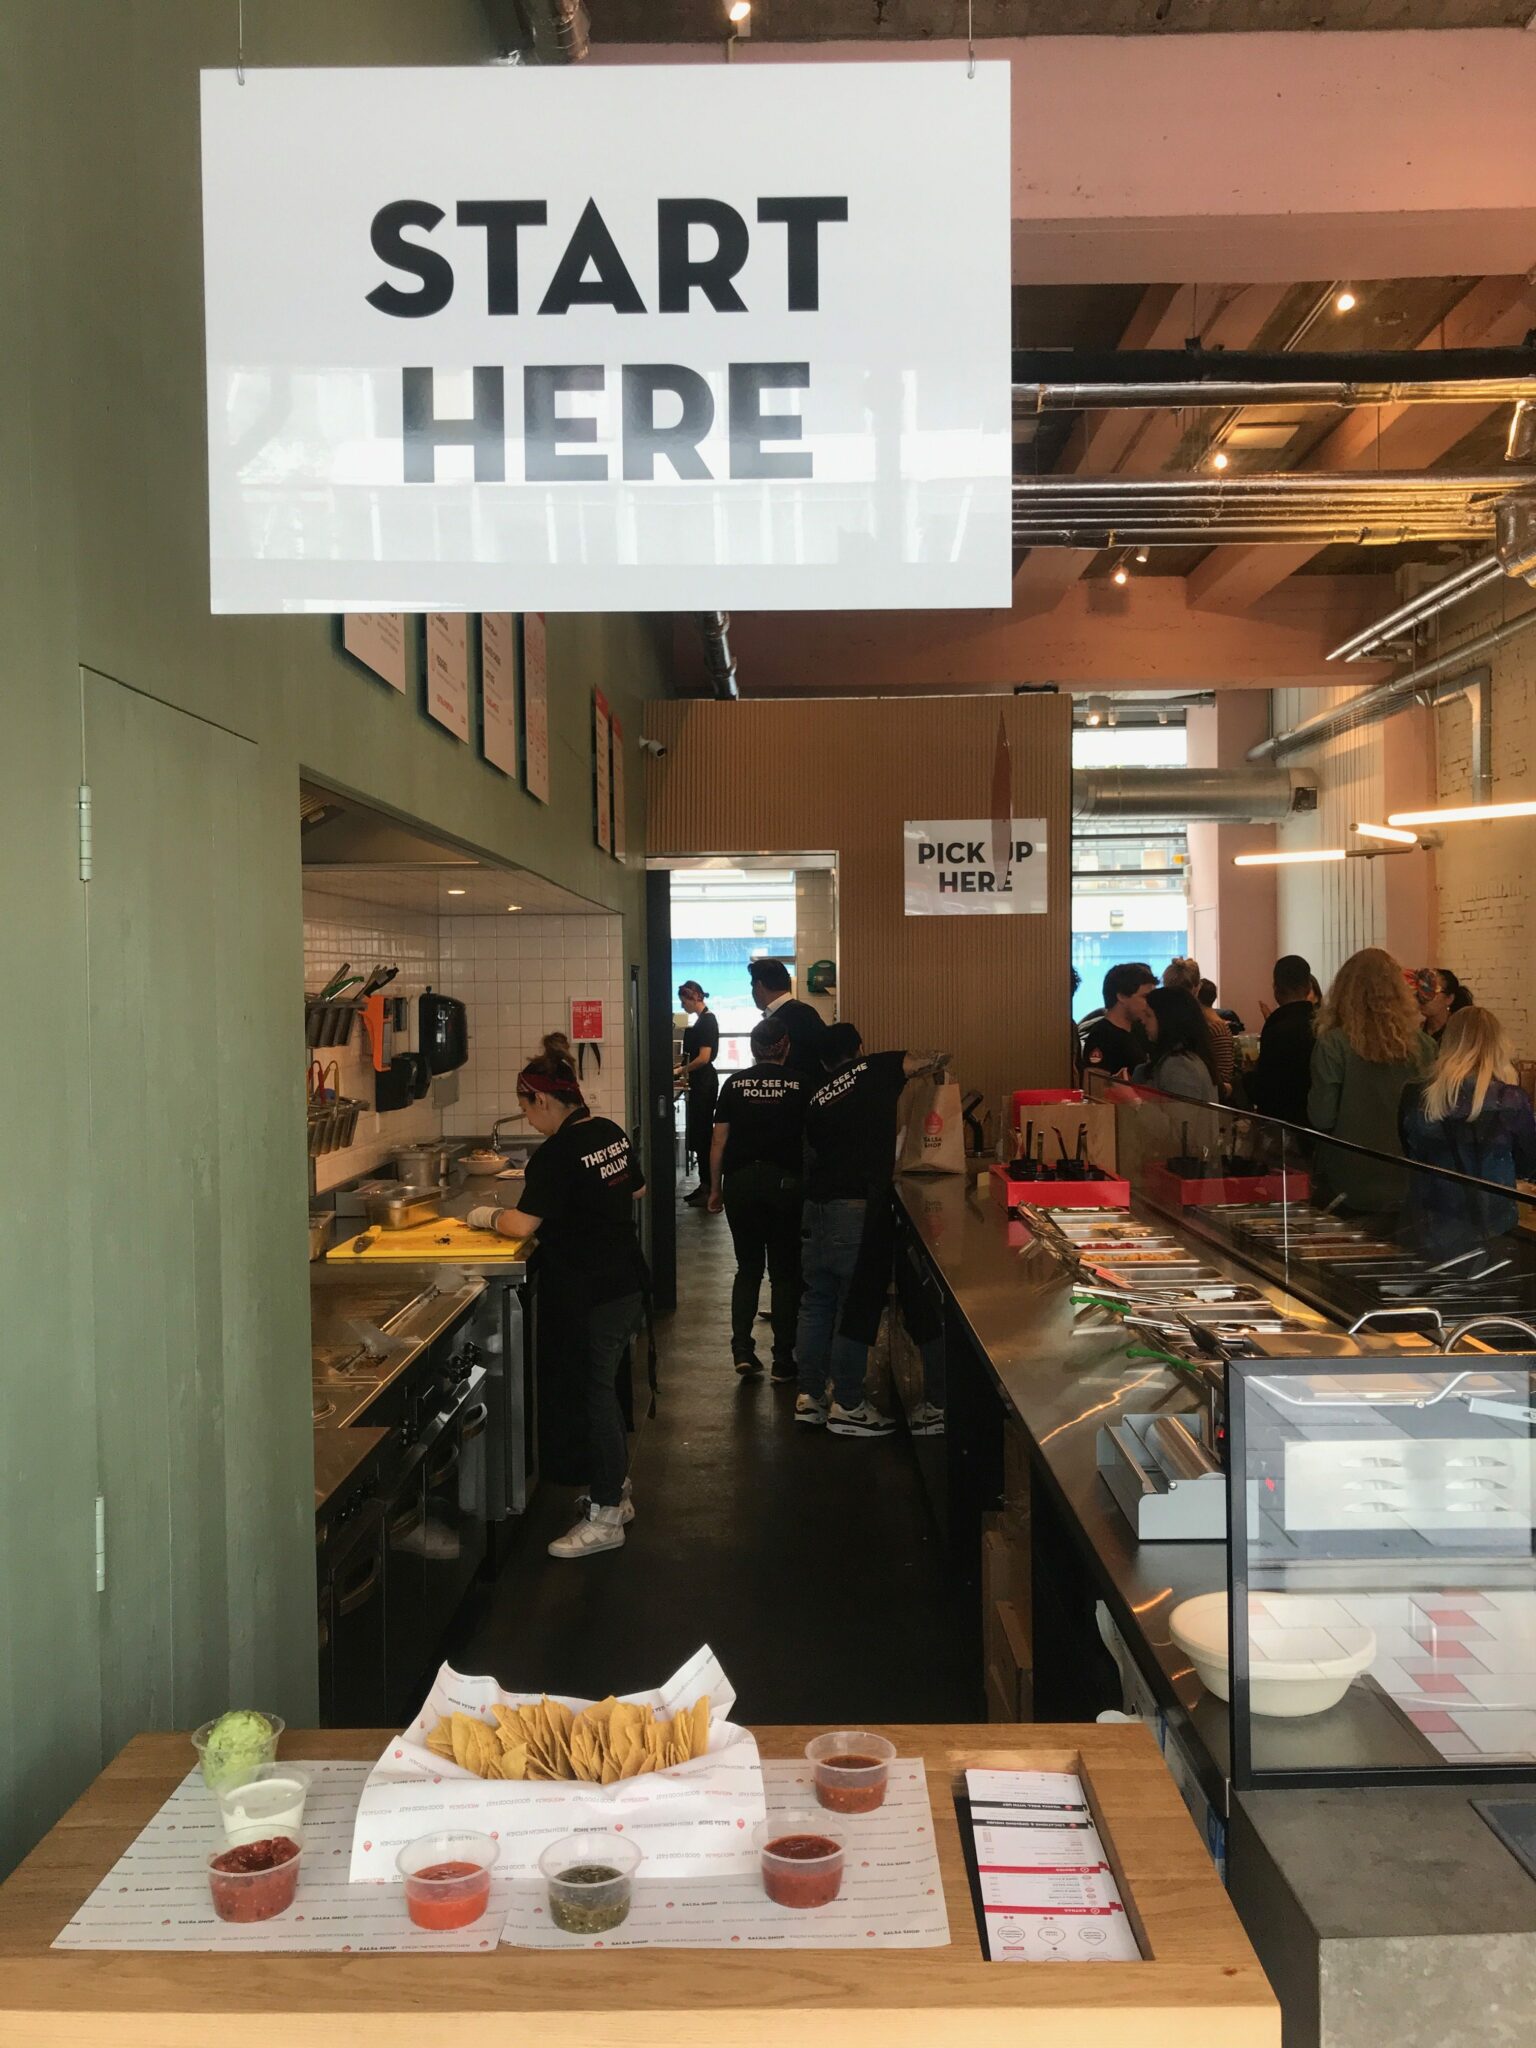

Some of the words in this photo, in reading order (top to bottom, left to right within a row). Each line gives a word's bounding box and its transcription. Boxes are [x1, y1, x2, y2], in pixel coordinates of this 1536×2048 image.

[364, 196, 848, 318] START
[402, 362, 814, 483] HERE
[918, 842, 986, 864] PICK
[939, 870, 1013, 893] HERE
[732, 1079, 760, 1089] THEY
[762, 1080, 781, 1088] SEE
[784, 1080, 800, 1090] ME
[832, 1072, 851, 1087] SEE
[852, 1062, 869, 1075] ME
[743, 1089, 786, 1098] ROLLIN'
[818, 1076, 857, 1106] ROLLIN'
[581, 1148, 608, 1168] THEY
[607, 1141, 622, 1158] SEE
[600, 1155, 628, 1179] ROLLIN'
